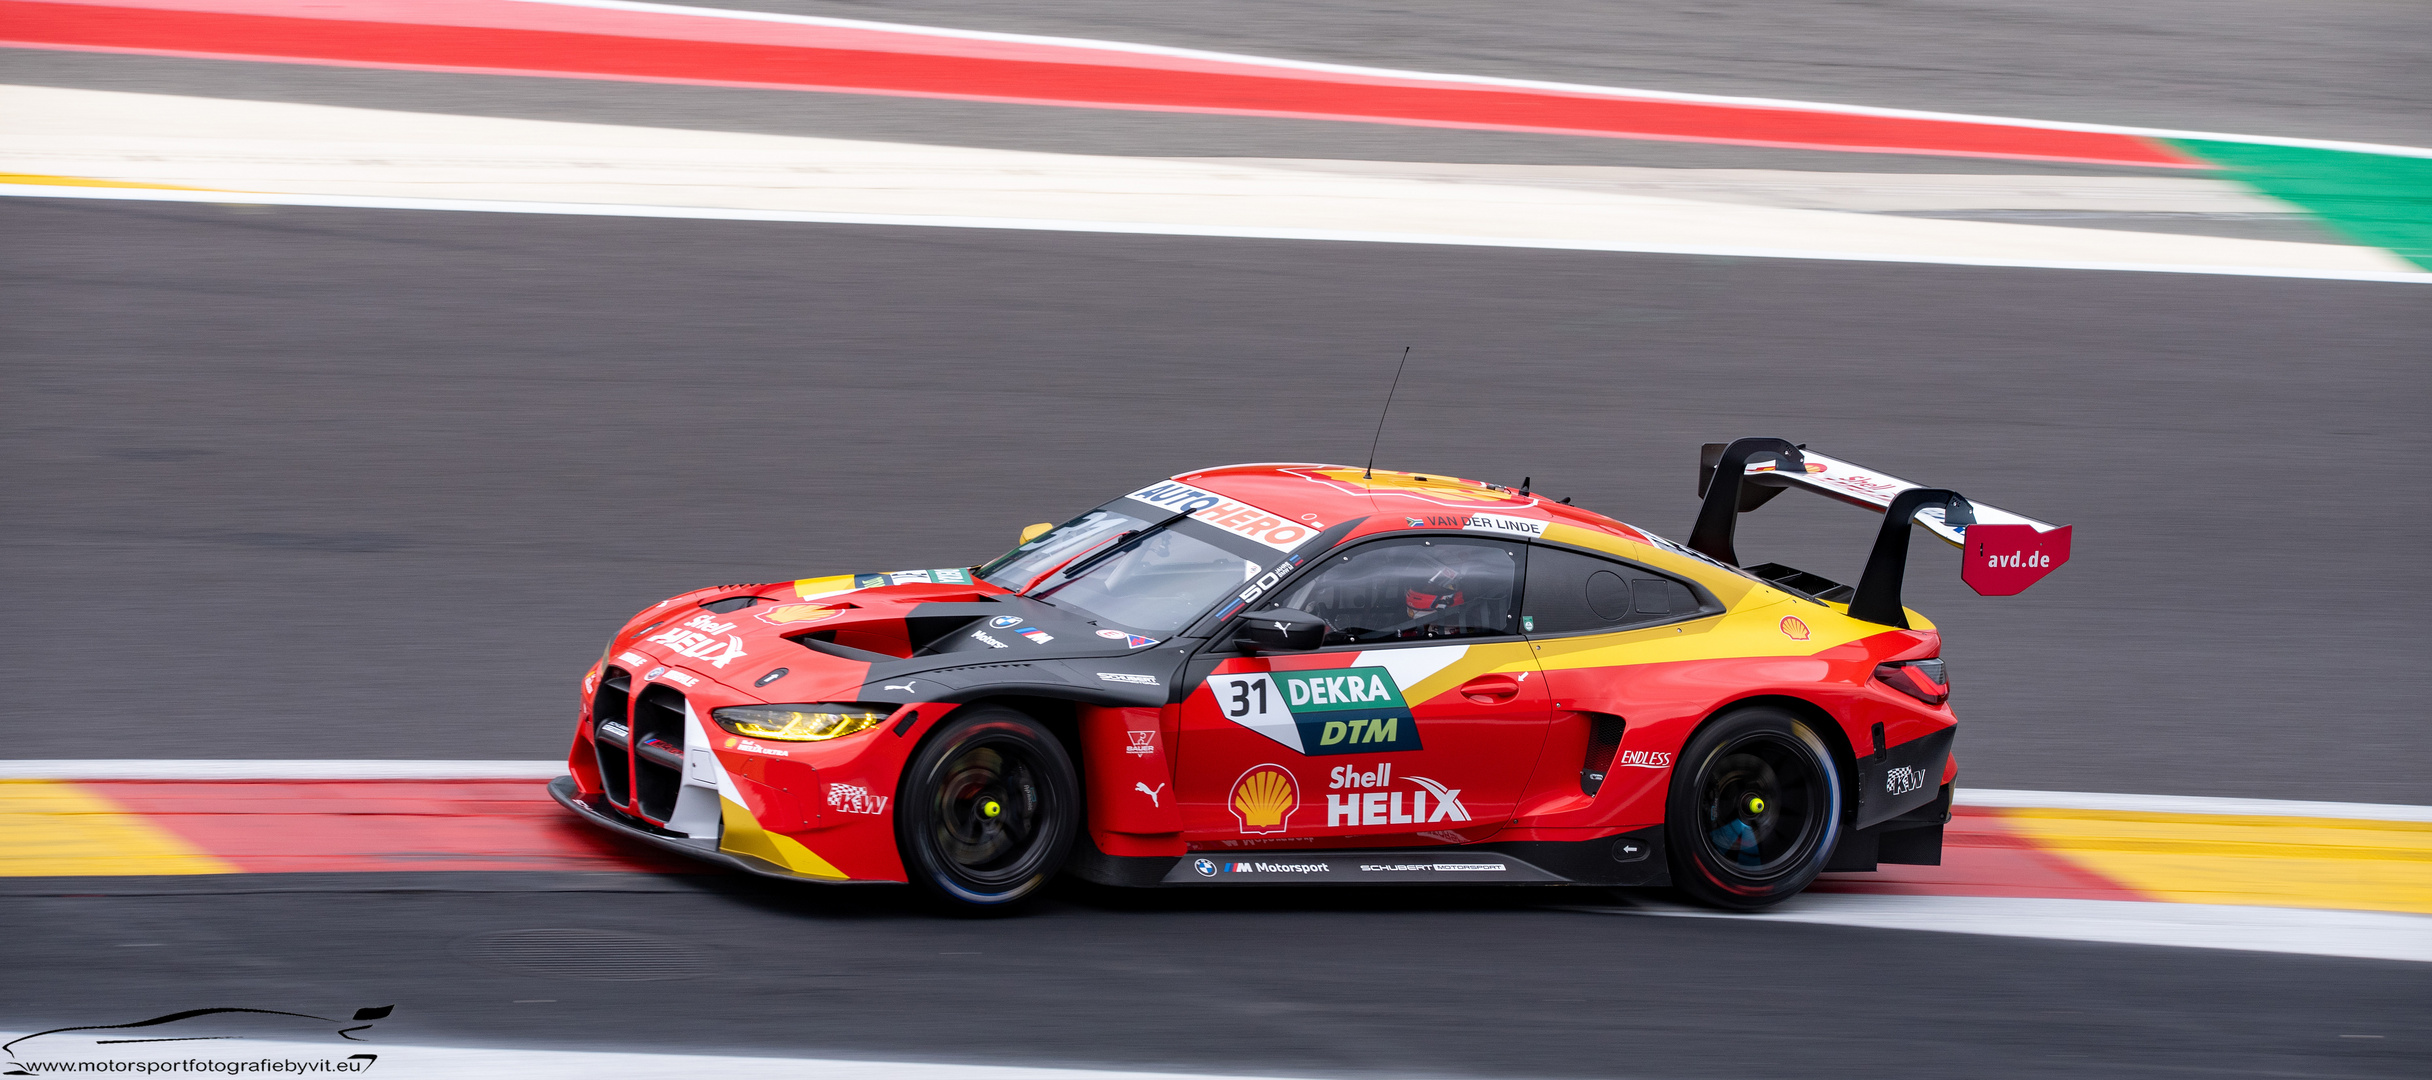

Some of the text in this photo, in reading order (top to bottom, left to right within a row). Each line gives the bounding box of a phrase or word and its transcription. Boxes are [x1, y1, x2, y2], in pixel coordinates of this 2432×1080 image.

[1135, 483, 1306, 545] AUTOHERO
[1427, 516, 1541, 534] VAN DER LINDE
[1988, 550, 2050, 568] avd.de
[1238, 571, 1280, 603] 50
[683, 614, 738, 636] Shell
[646, 627, 748, 669] HELIX
[1230, 678, 1267, 717] 31
[1287, 674, 1391, 706] DEKRA
[1319, 717, 1398, 746] DTM
[1620, 750, 1671, 766] ENDLESS
[1328, 762, 1391, 789] Shell
[1892, 768, 1926, 795] KW
[836, 793, 888, 815] KW
[1325, 776, 1472, 827] HELIX
[1255, 862, 1330, 874] Motorsport
